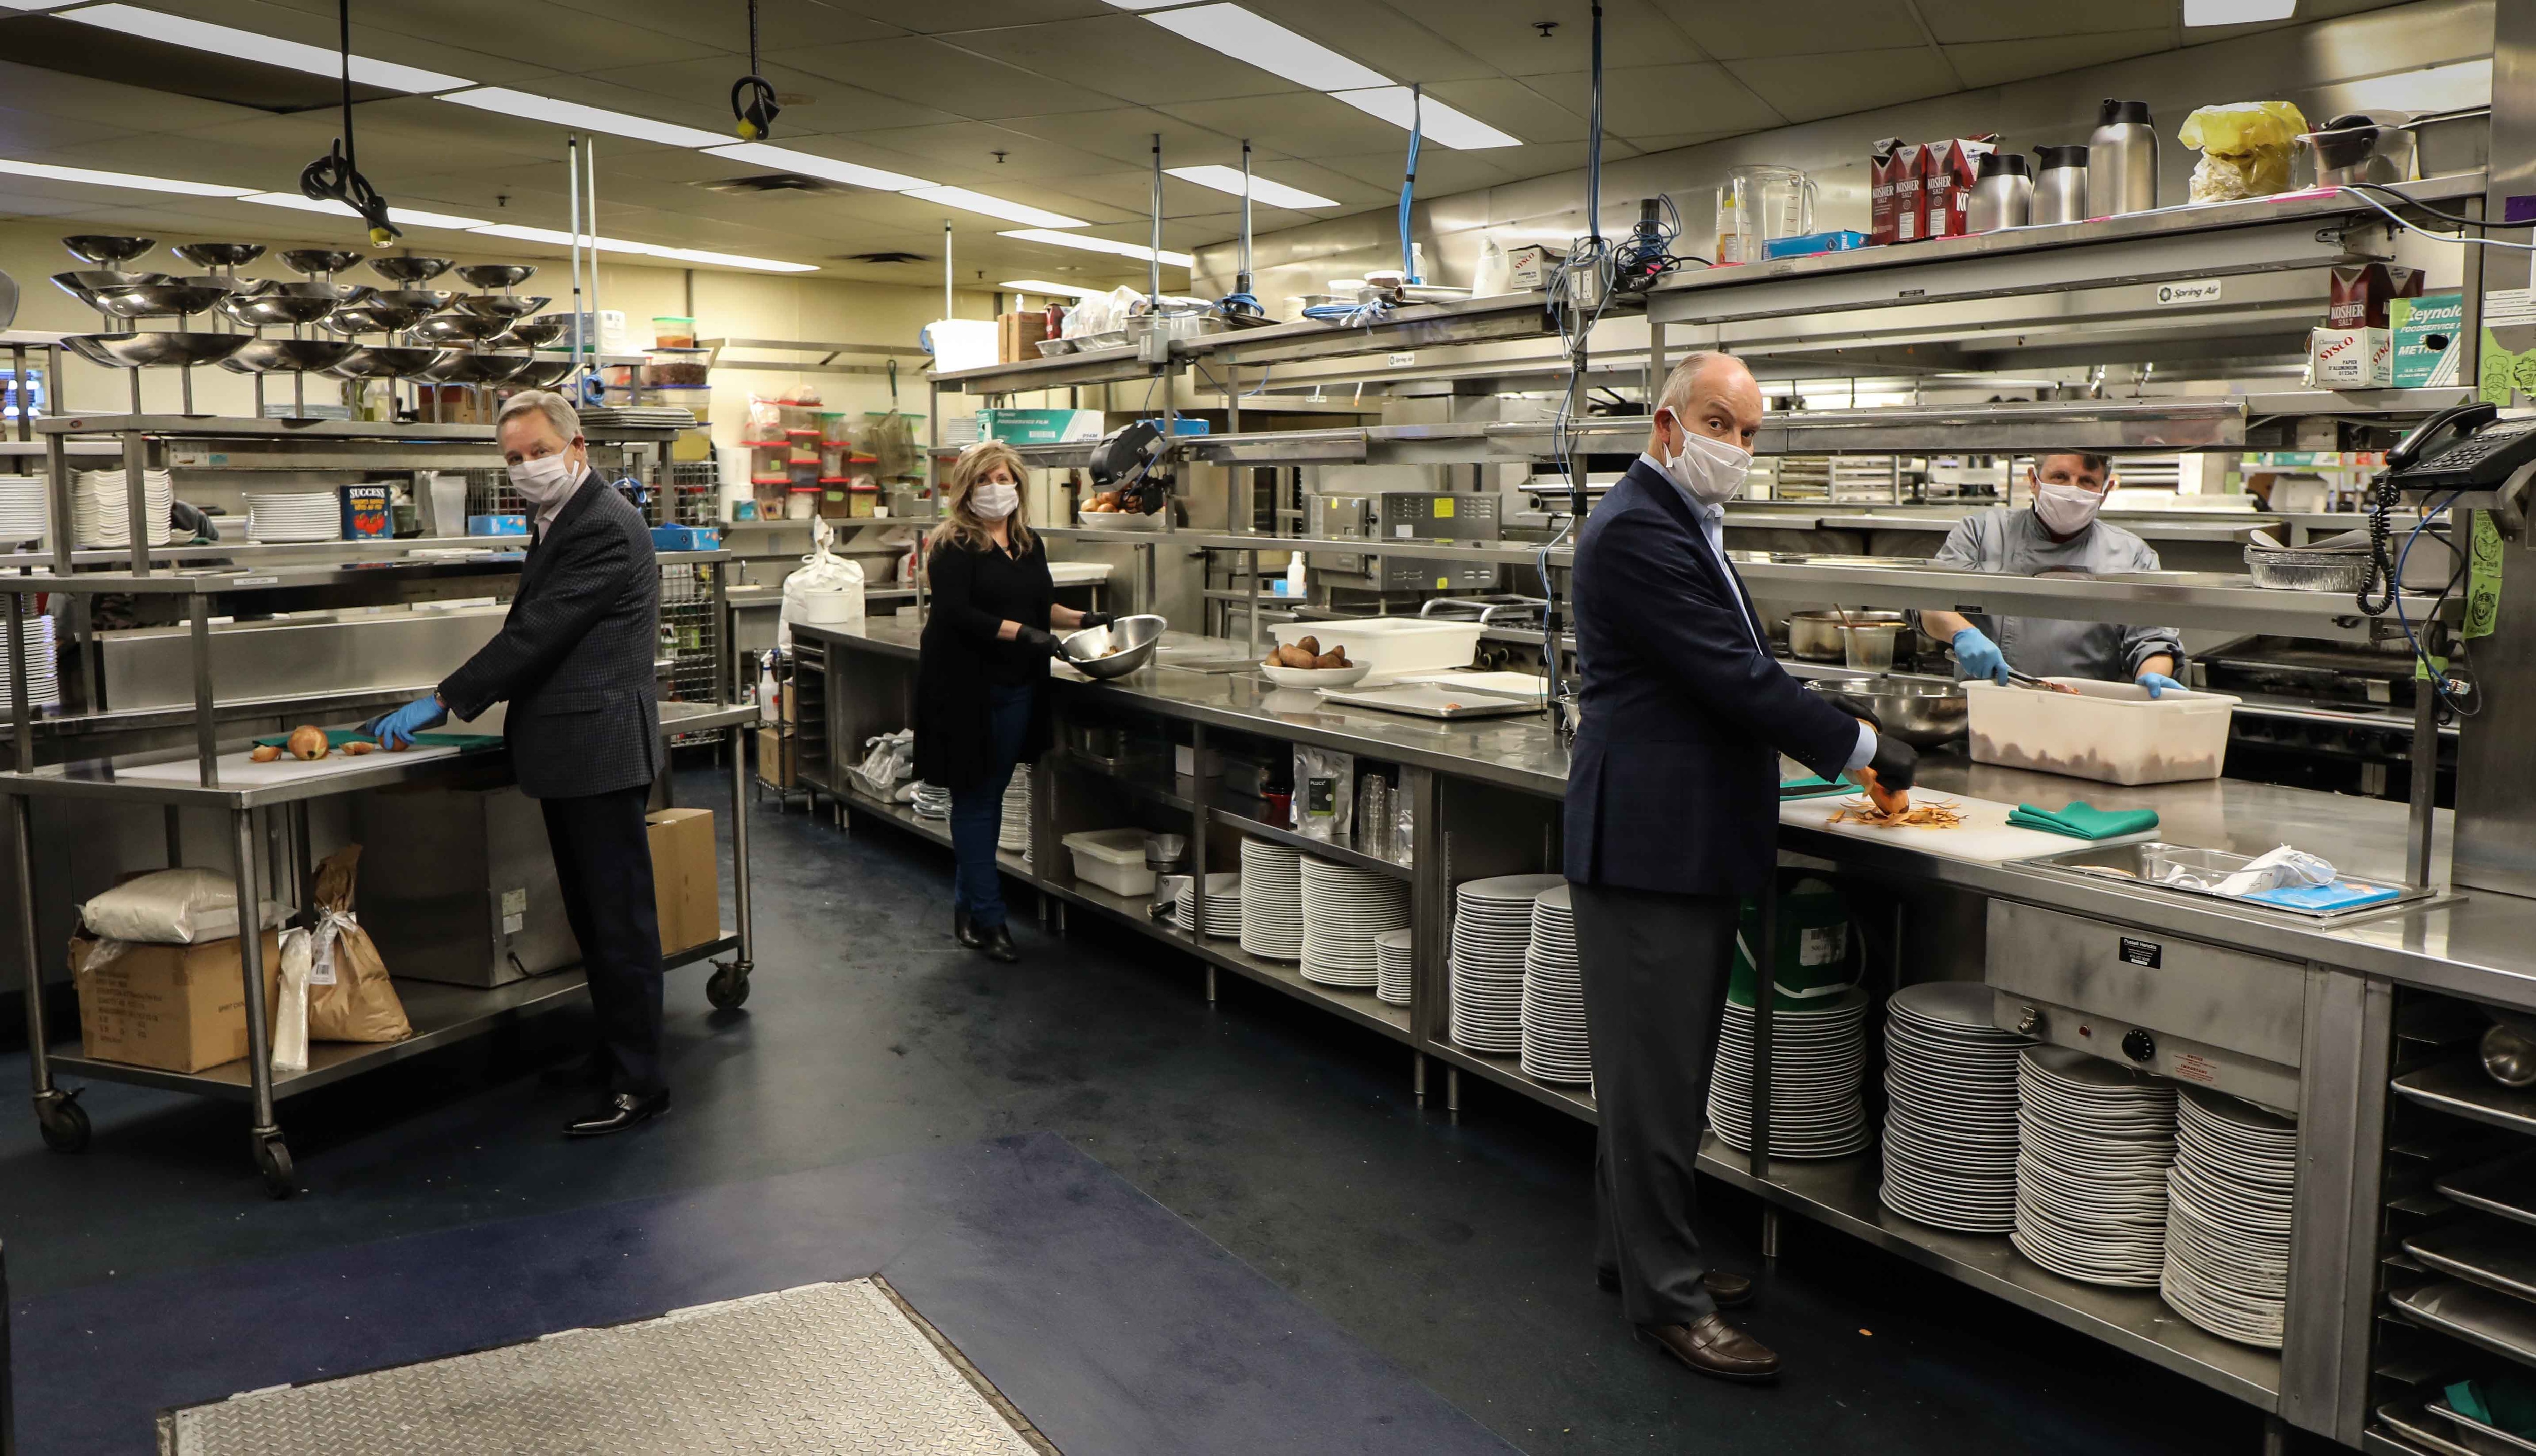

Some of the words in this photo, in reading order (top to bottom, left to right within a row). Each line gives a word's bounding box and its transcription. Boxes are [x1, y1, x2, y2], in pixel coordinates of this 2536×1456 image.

[1896, 180, 1919, 193] KOSHER
[1928, 176, 1951, 190] KOSHER
[1872, 185, 1894, 199] KOSHER
[1514, 253, 1534, 269] SYSCO
[2173, 288, 2202, 299] Spring
[2204, 285, 2219, 295] Air
[2331, 304, 2364, 320] KOSHER
[2400, 323, 2455, 333] FOODSERVICE
[2320, 337, 2353, 361] SYSCO
[349, 488, 385, 498] SUCCESS
[2181, 1064, 2207, 1074] IMPORTANT
